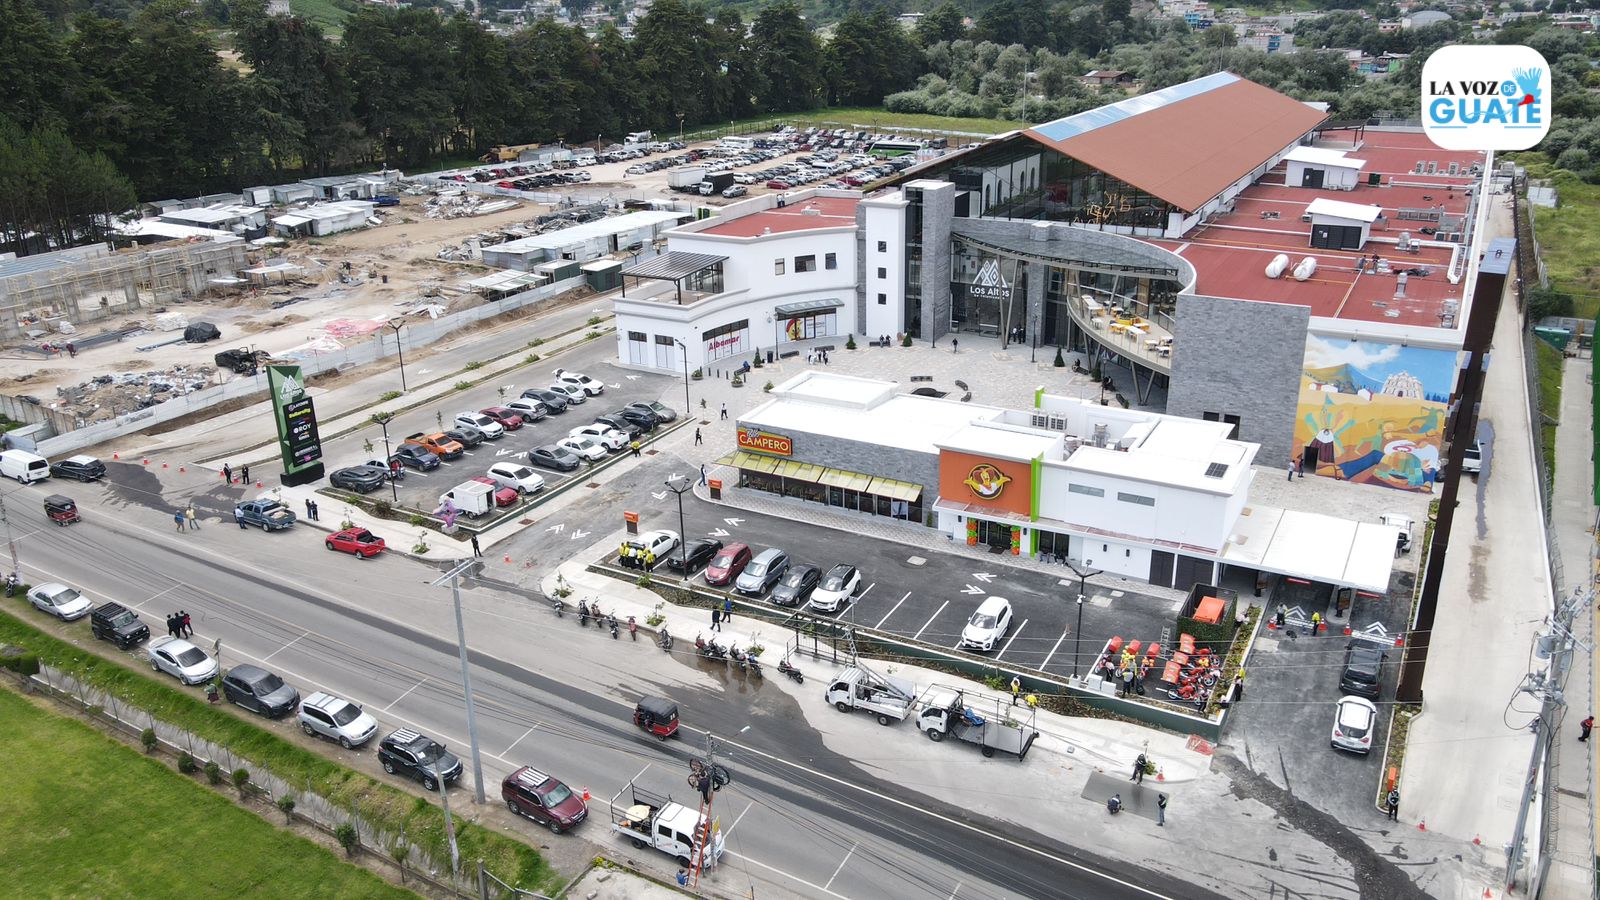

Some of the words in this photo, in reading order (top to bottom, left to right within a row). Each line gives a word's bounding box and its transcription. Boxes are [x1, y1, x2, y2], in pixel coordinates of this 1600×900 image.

[970, 286, 986, 294] Los
[708, 335, 740, 351] Albamar
[739, 434, 789, 451] CAMPERO
